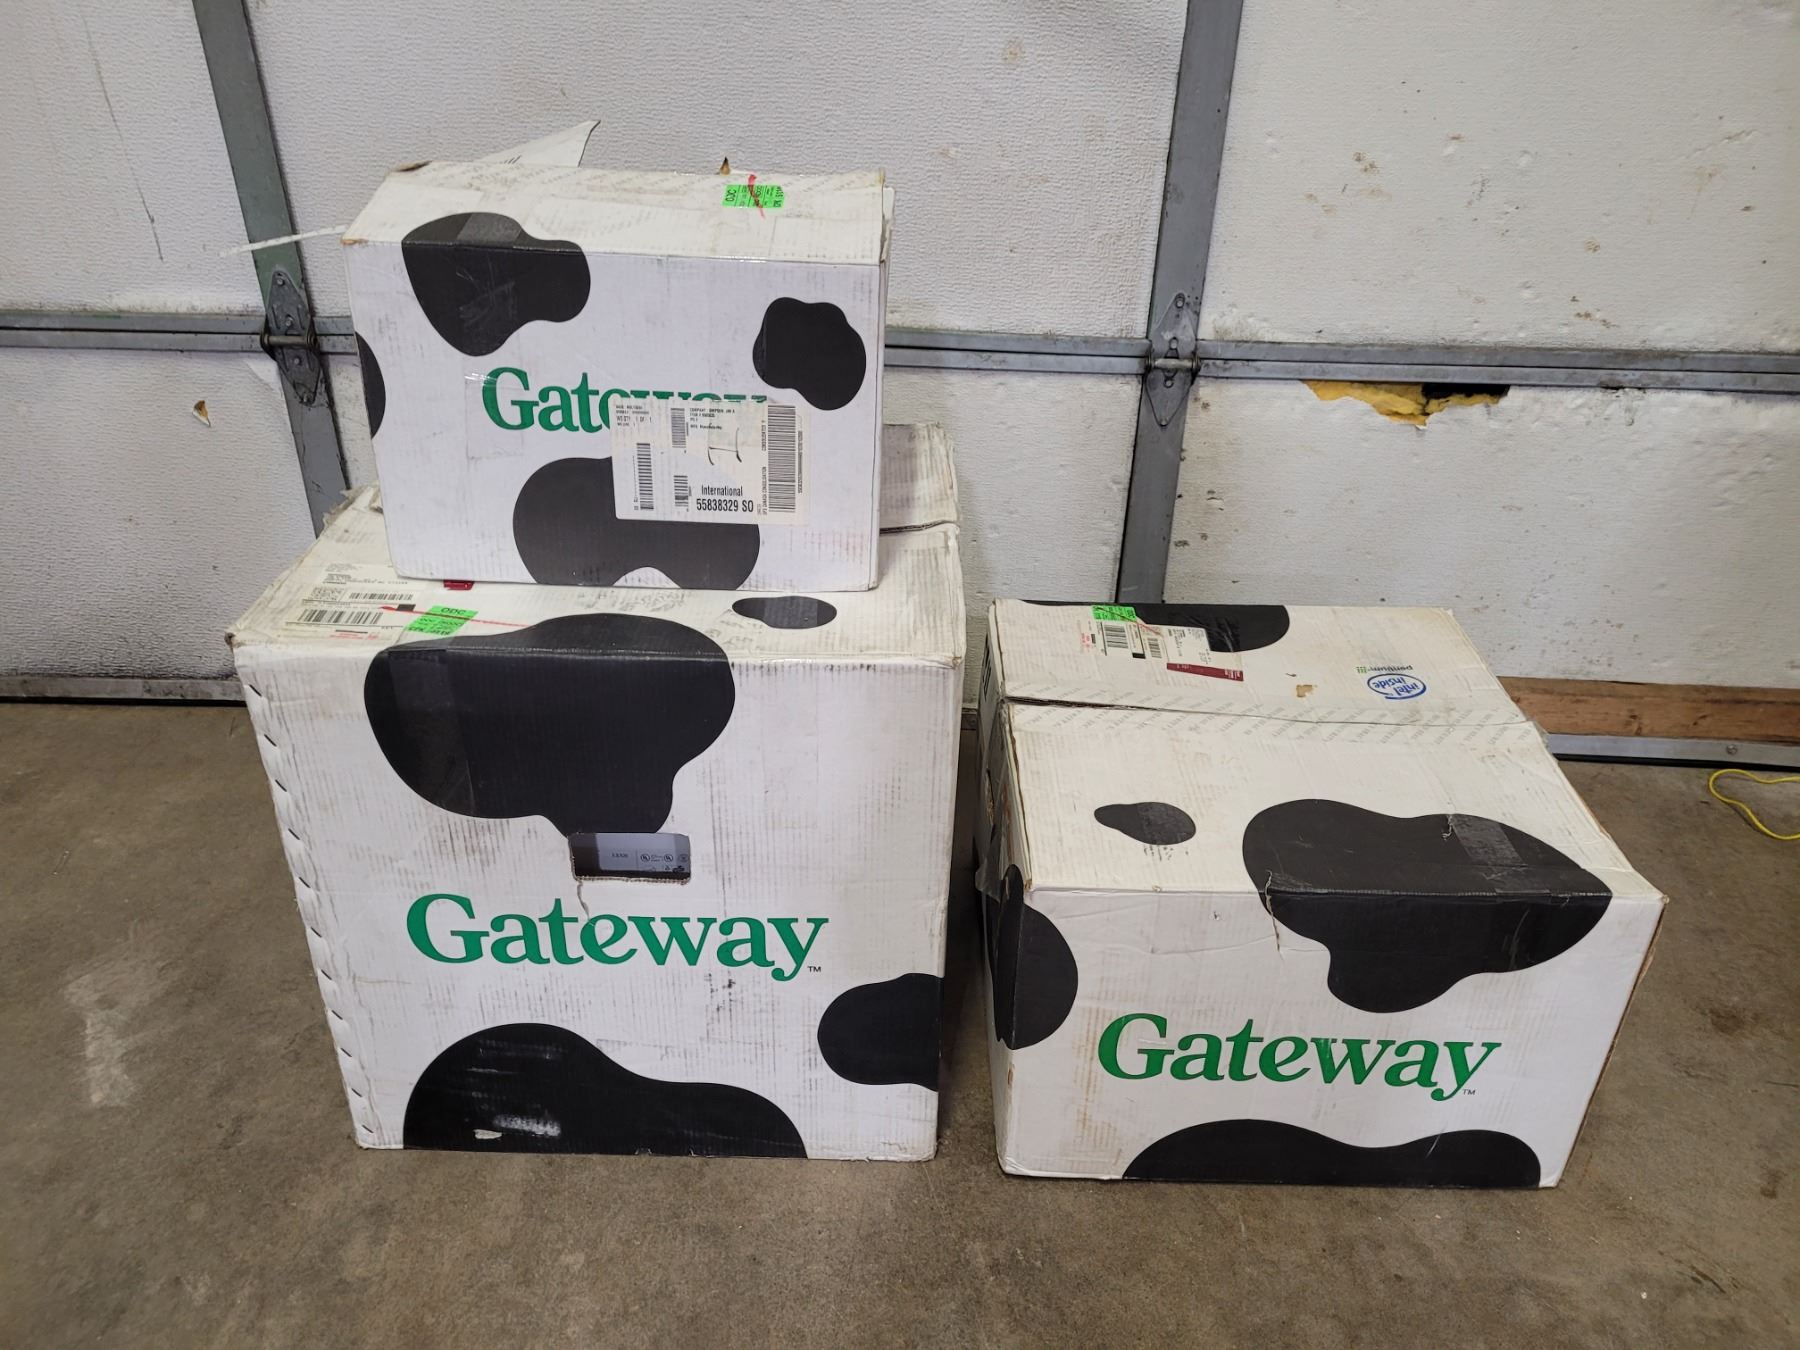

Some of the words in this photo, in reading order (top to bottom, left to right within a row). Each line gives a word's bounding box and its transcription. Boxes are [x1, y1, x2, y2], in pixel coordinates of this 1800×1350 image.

[701, 484, 743, 497] International
[696, 498, 739, 512] 55838329
[741, 500, 754, 513] SO
[440, 607, 467, 615] ODC
[1372, 676, 1408, 689] inside
[1392, 682, 1420, 696] intel
[406, 893, 830, 982] Gateway
[1097, 1013, 1501, 1102] Gateway
